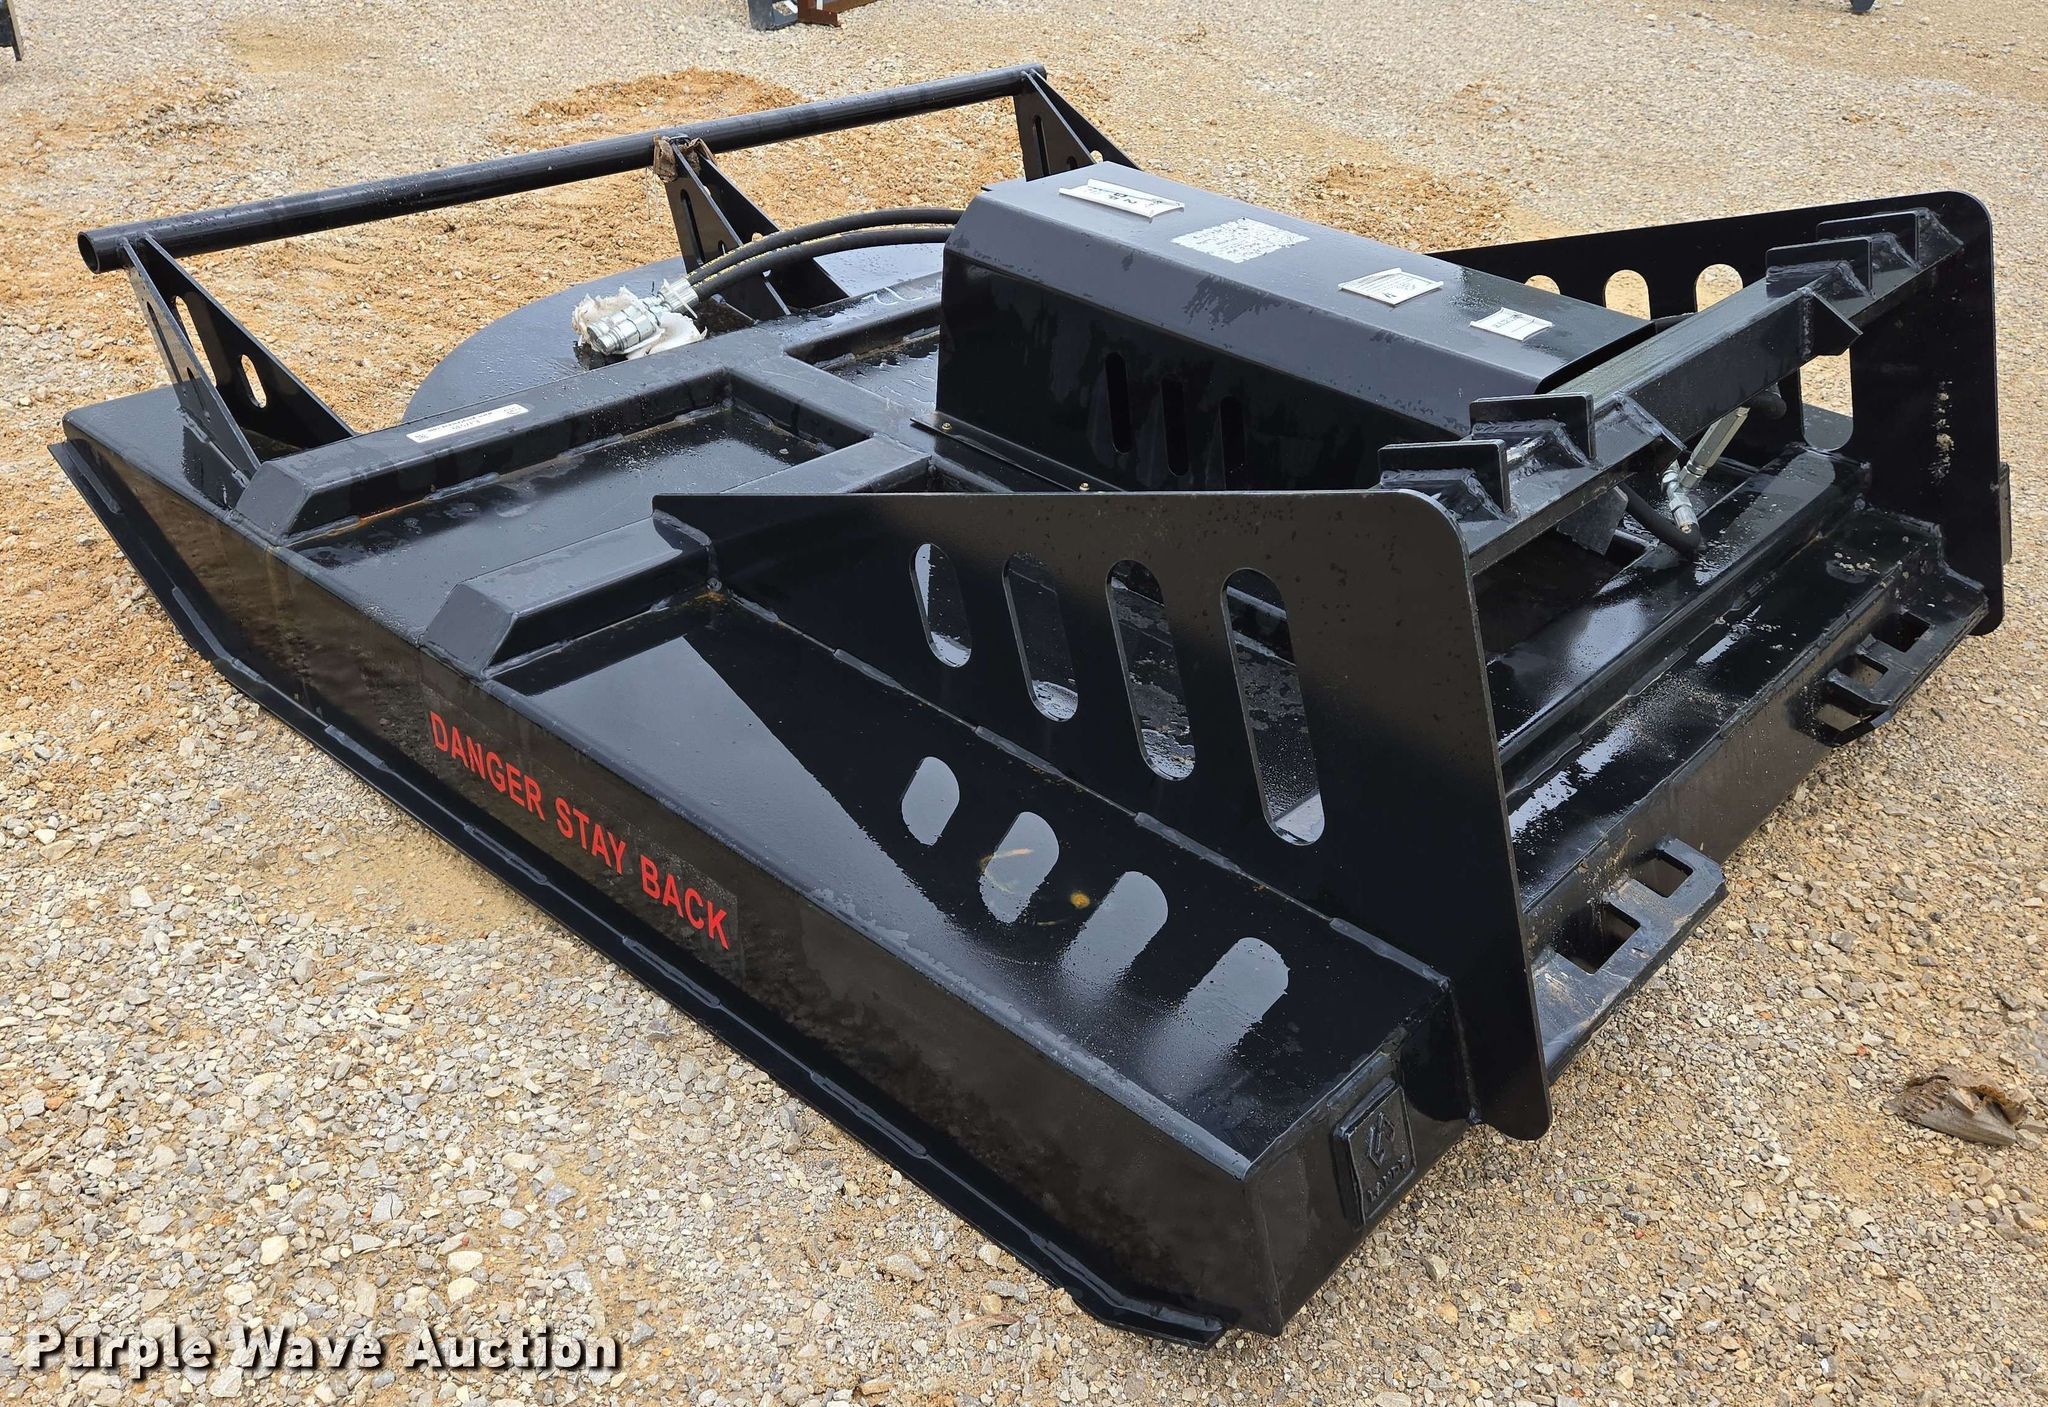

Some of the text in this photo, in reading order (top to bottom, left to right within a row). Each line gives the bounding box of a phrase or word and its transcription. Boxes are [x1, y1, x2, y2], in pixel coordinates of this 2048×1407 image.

[430, 711, 729, 950] DANGER STAY BACK
